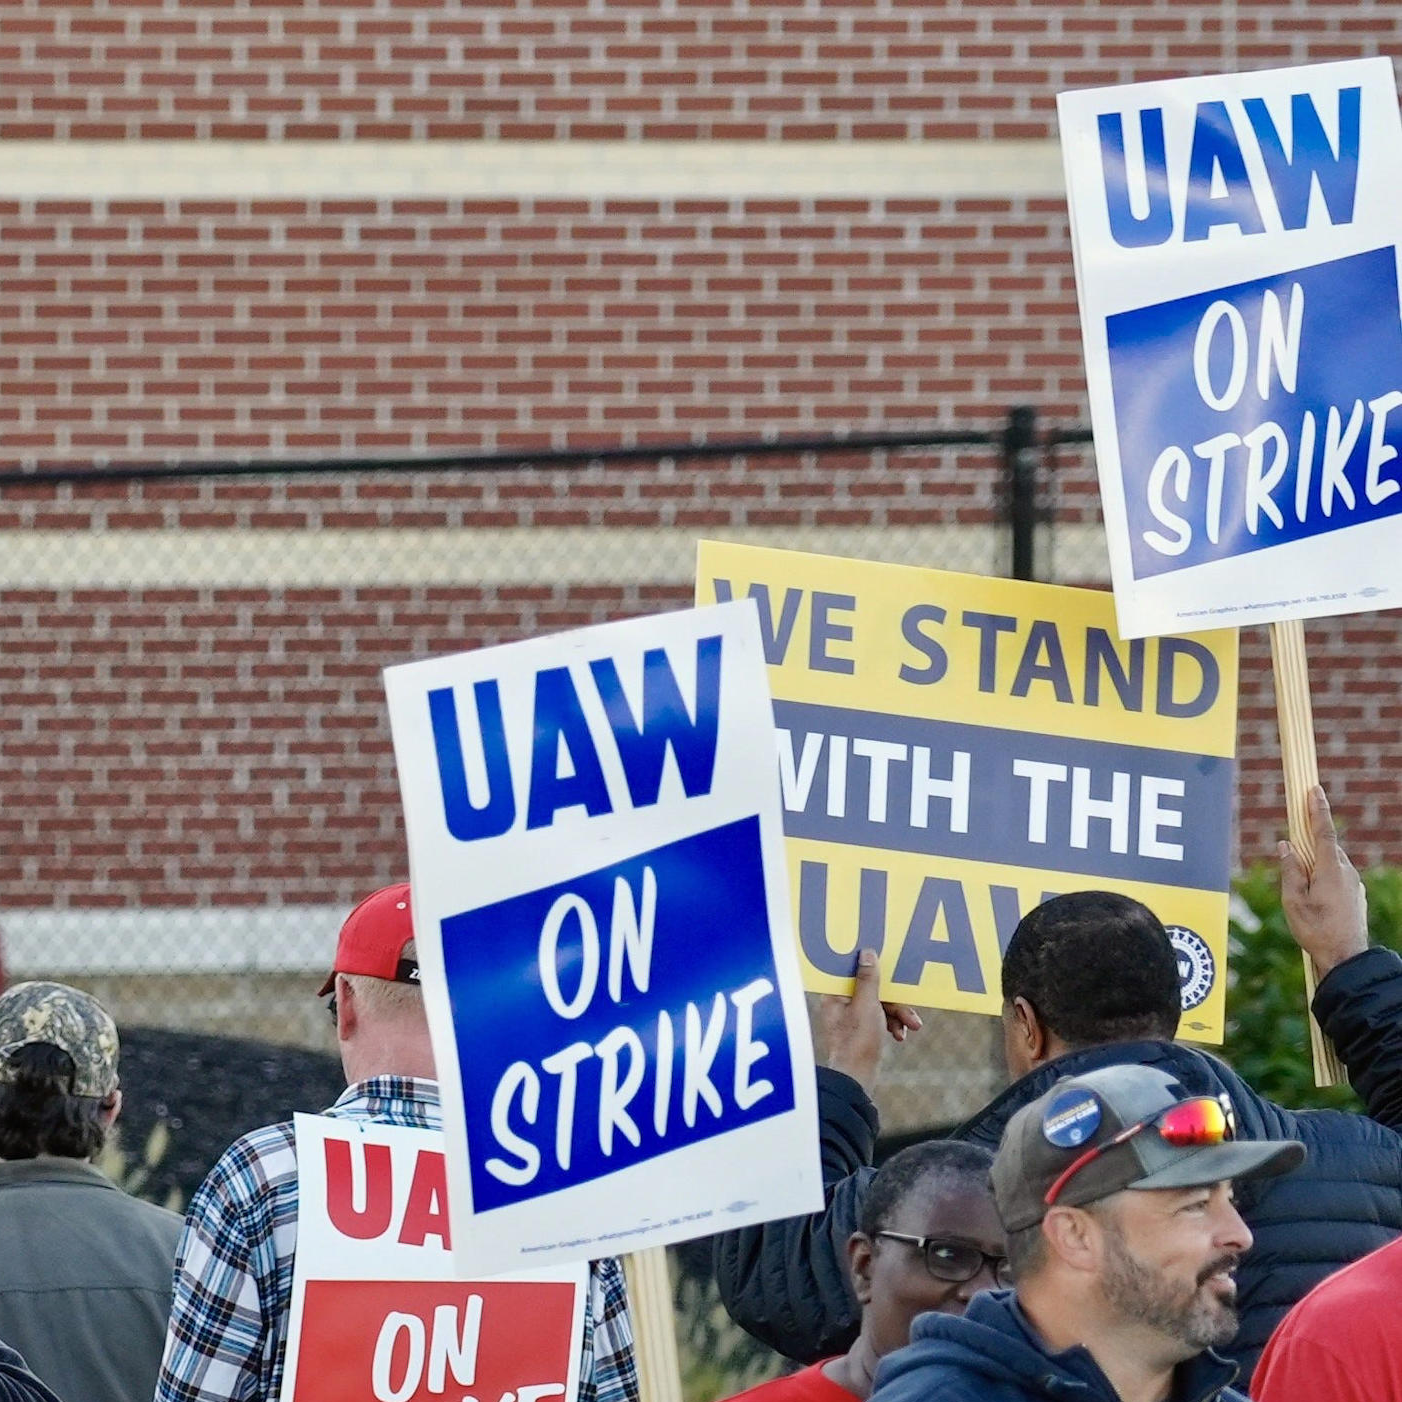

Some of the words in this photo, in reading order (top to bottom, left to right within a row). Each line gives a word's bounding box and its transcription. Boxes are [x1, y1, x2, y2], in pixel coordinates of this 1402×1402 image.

[1096, 87, 1362, 249] UAW
[1193, 282, 1305, 411] ON
[1142, 391, 1402, 557] STRIKE
[713, 578, 856, 675] WE
[898, 604, 1220, 719] STAND
[427, 635, 724, 842] UAW
[775, 727, 971, 833] WITH
[1012, 759, 1185, 861] THE
[538, 865, 658, 1020] ON
[485, 978, 774, 1186] STRIKE
[324, 1138, 451, 1251] UA
